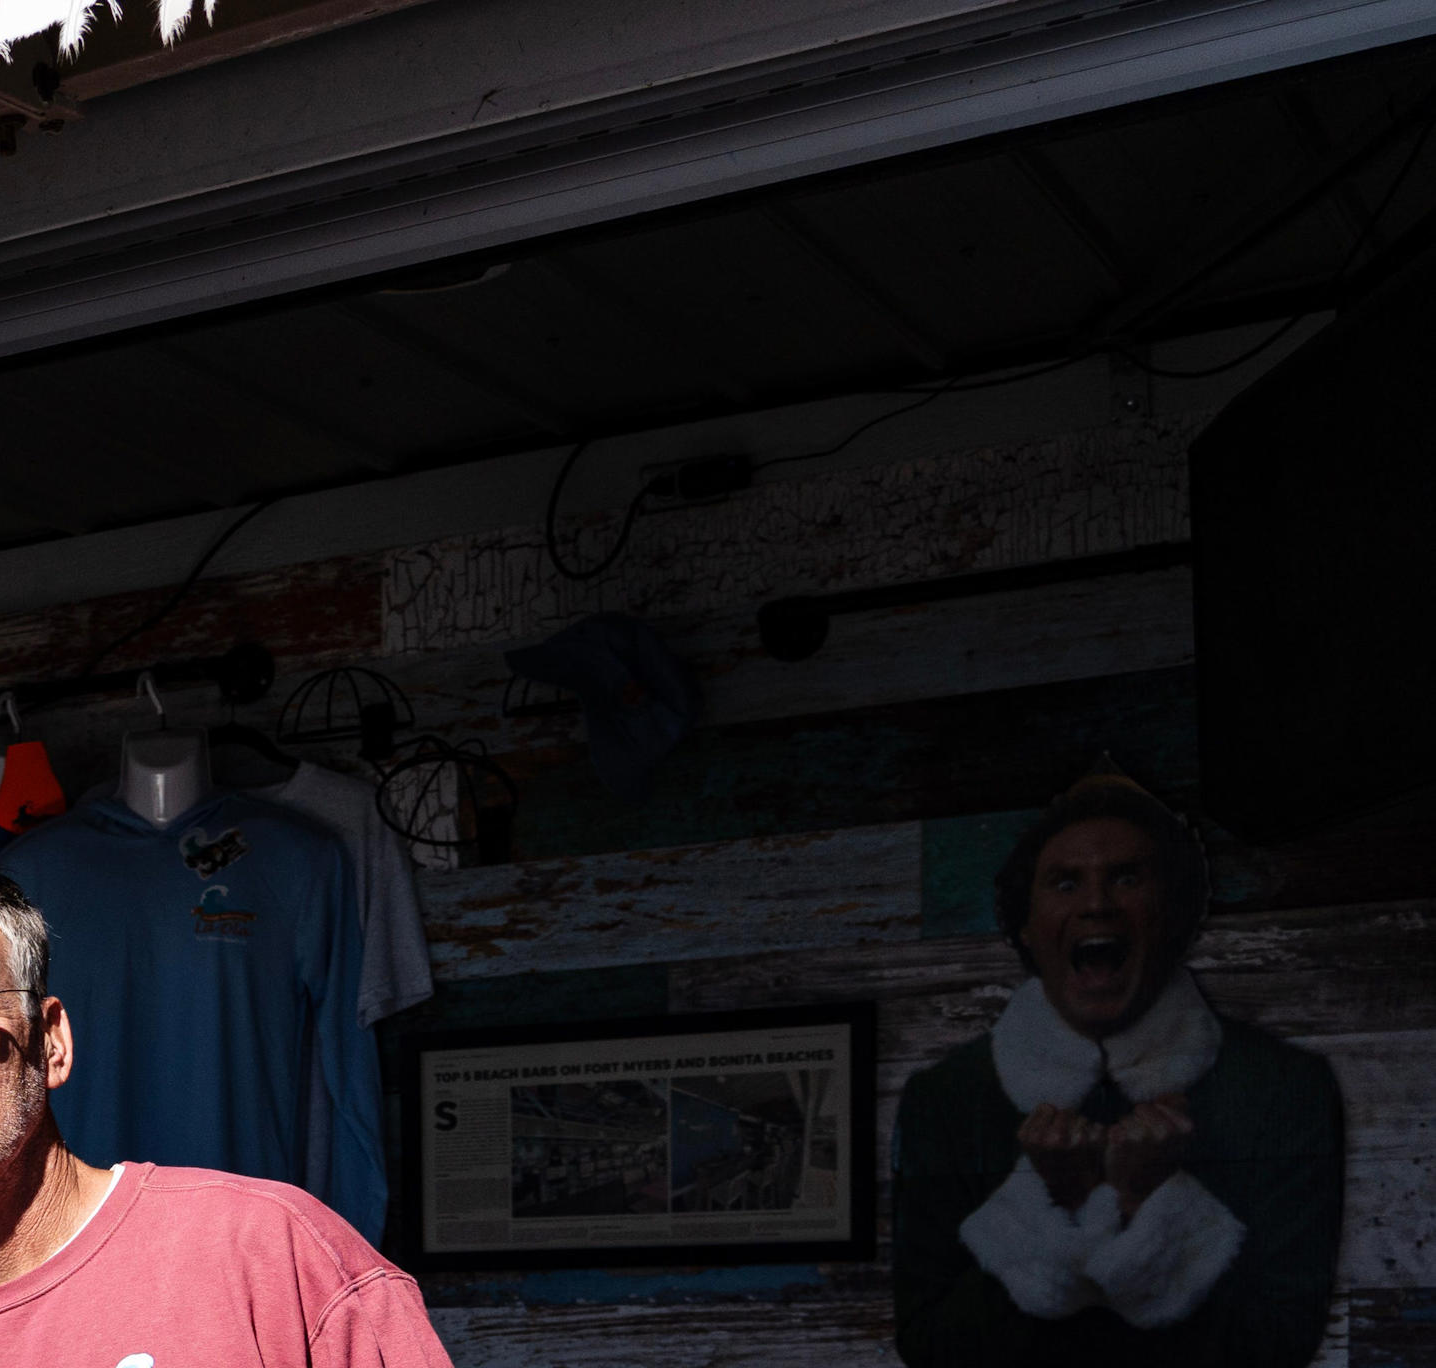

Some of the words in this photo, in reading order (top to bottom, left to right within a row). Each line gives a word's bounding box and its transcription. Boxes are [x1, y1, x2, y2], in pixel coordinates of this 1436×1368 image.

[434, 1071, 460, 1083] TOP
[463, 1071, 470, 1082] 5
[474, 1068, 518, 1081] BEACH
[522, 1066, 557, 1079] BARS
[560, 1064, 581, 1076] ON
[584, 1061, 619, 1074] FORT
[623, 1058, 671, 1072] MYERS
[675, 1056, 705, 1069] AND
[709, 1053, 763, 1067] BONITA
[767, 1049, 834, 1063] BEACHES
[434, 1101, 458, 1131] S
